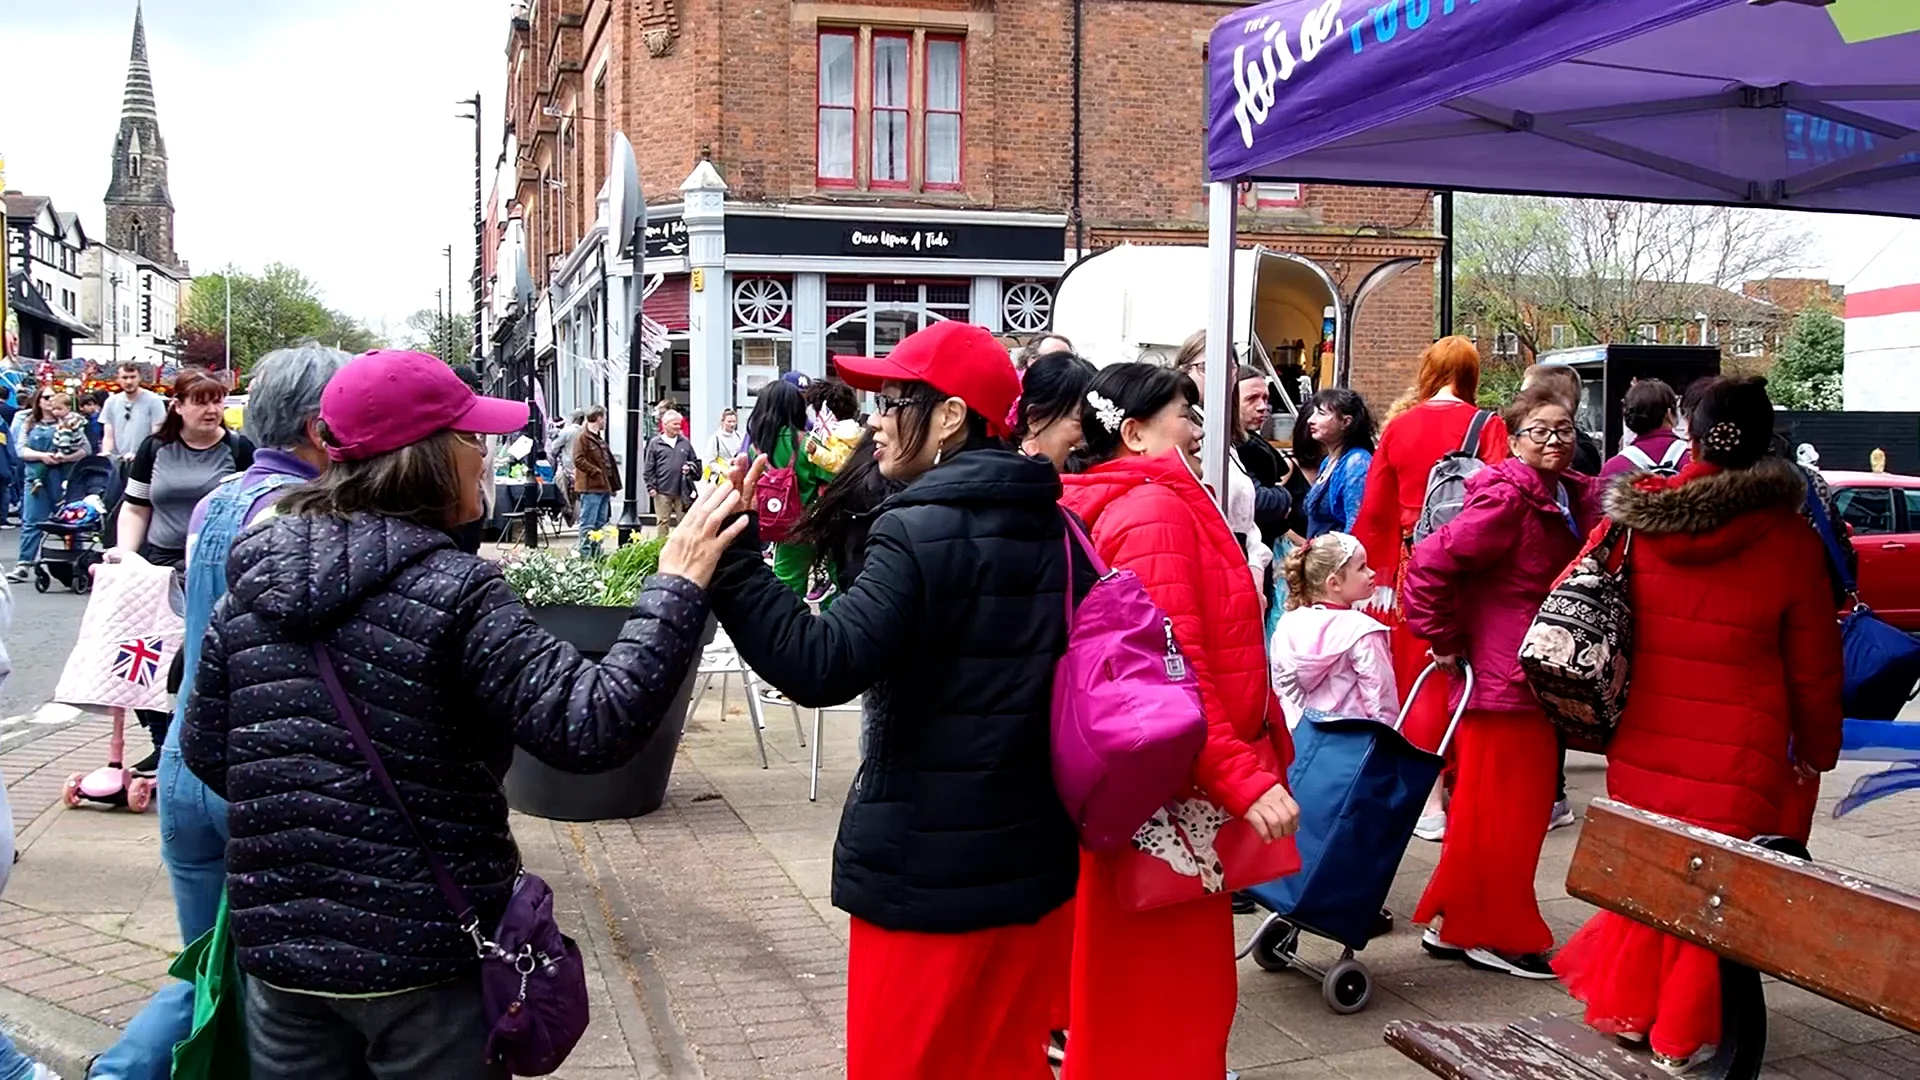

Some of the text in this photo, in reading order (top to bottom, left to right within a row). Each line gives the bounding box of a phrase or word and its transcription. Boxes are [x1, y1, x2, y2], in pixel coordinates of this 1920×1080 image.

[1244, 15, 1271, 33] THE
[852, 231, 949, 251] Once Upon A Tide
